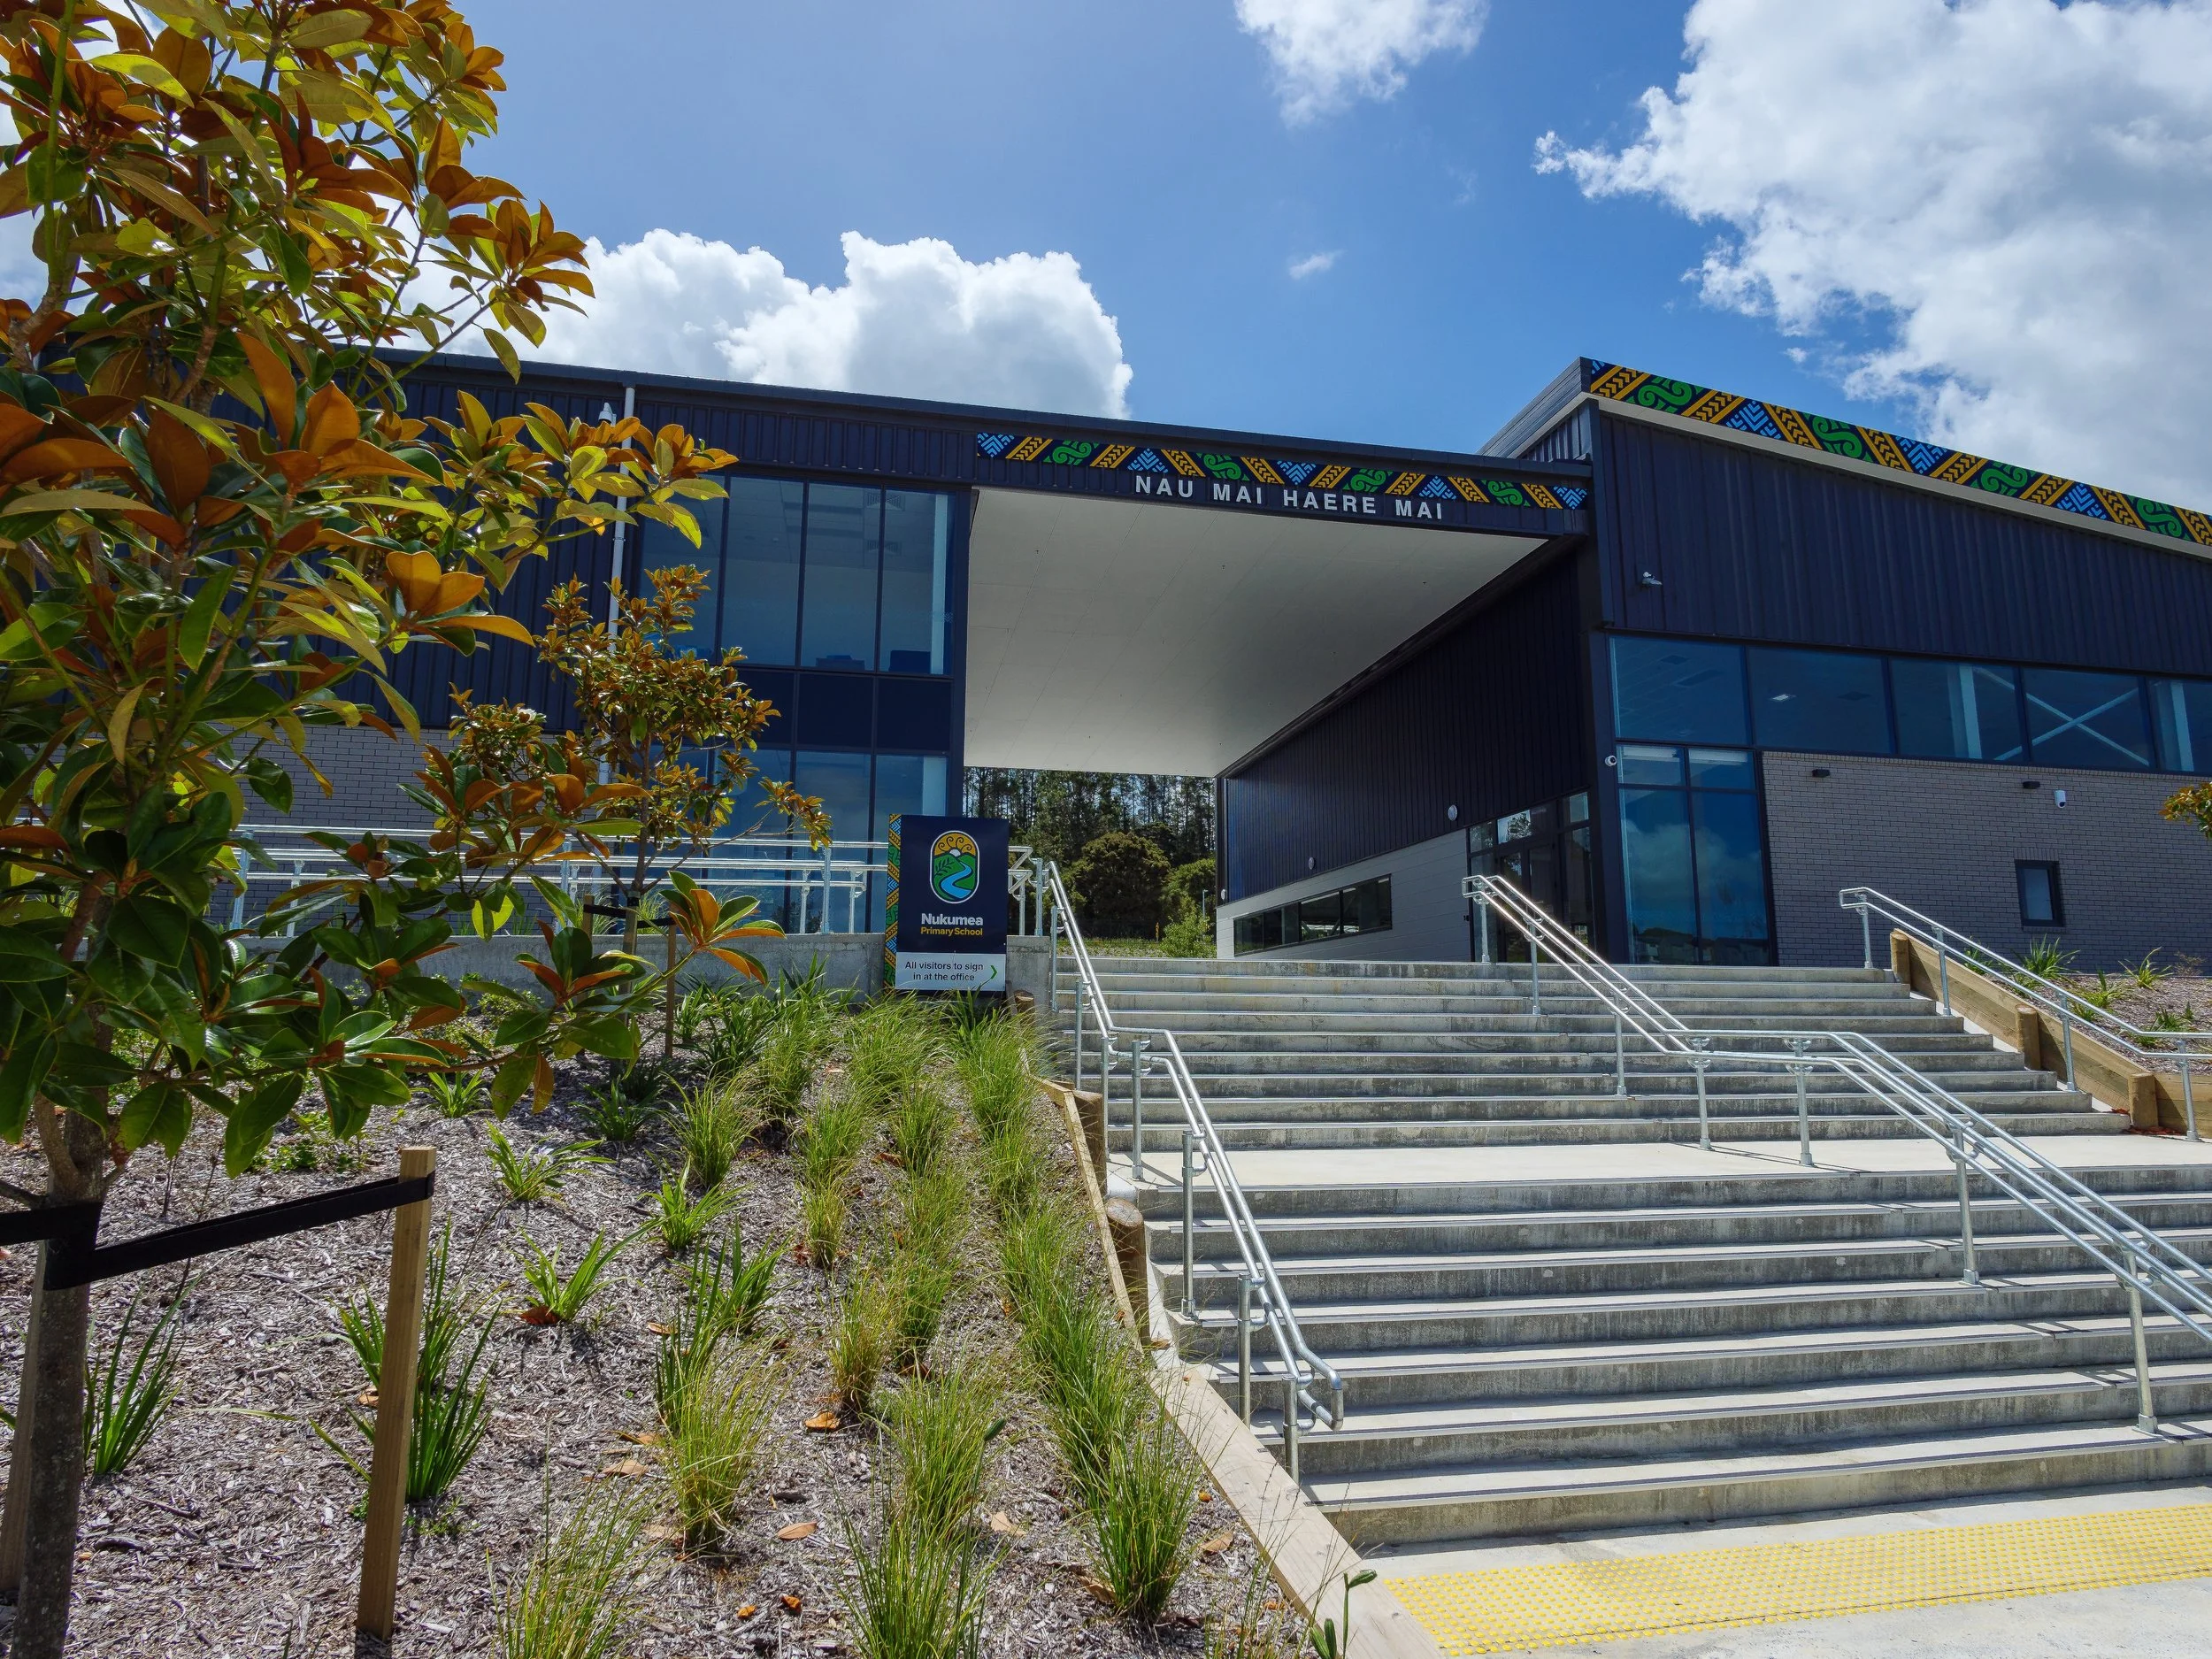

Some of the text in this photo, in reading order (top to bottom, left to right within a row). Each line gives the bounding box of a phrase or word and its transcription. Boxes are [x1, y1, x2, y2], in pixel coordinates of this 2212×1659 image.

[1136, 475, 1442, 519] NAU MAI HAERE MAI
[921, 912, 984, 926] Nukumea
[920, 926, 954, 937] Primary
[964, 963, 983, 972] sign
